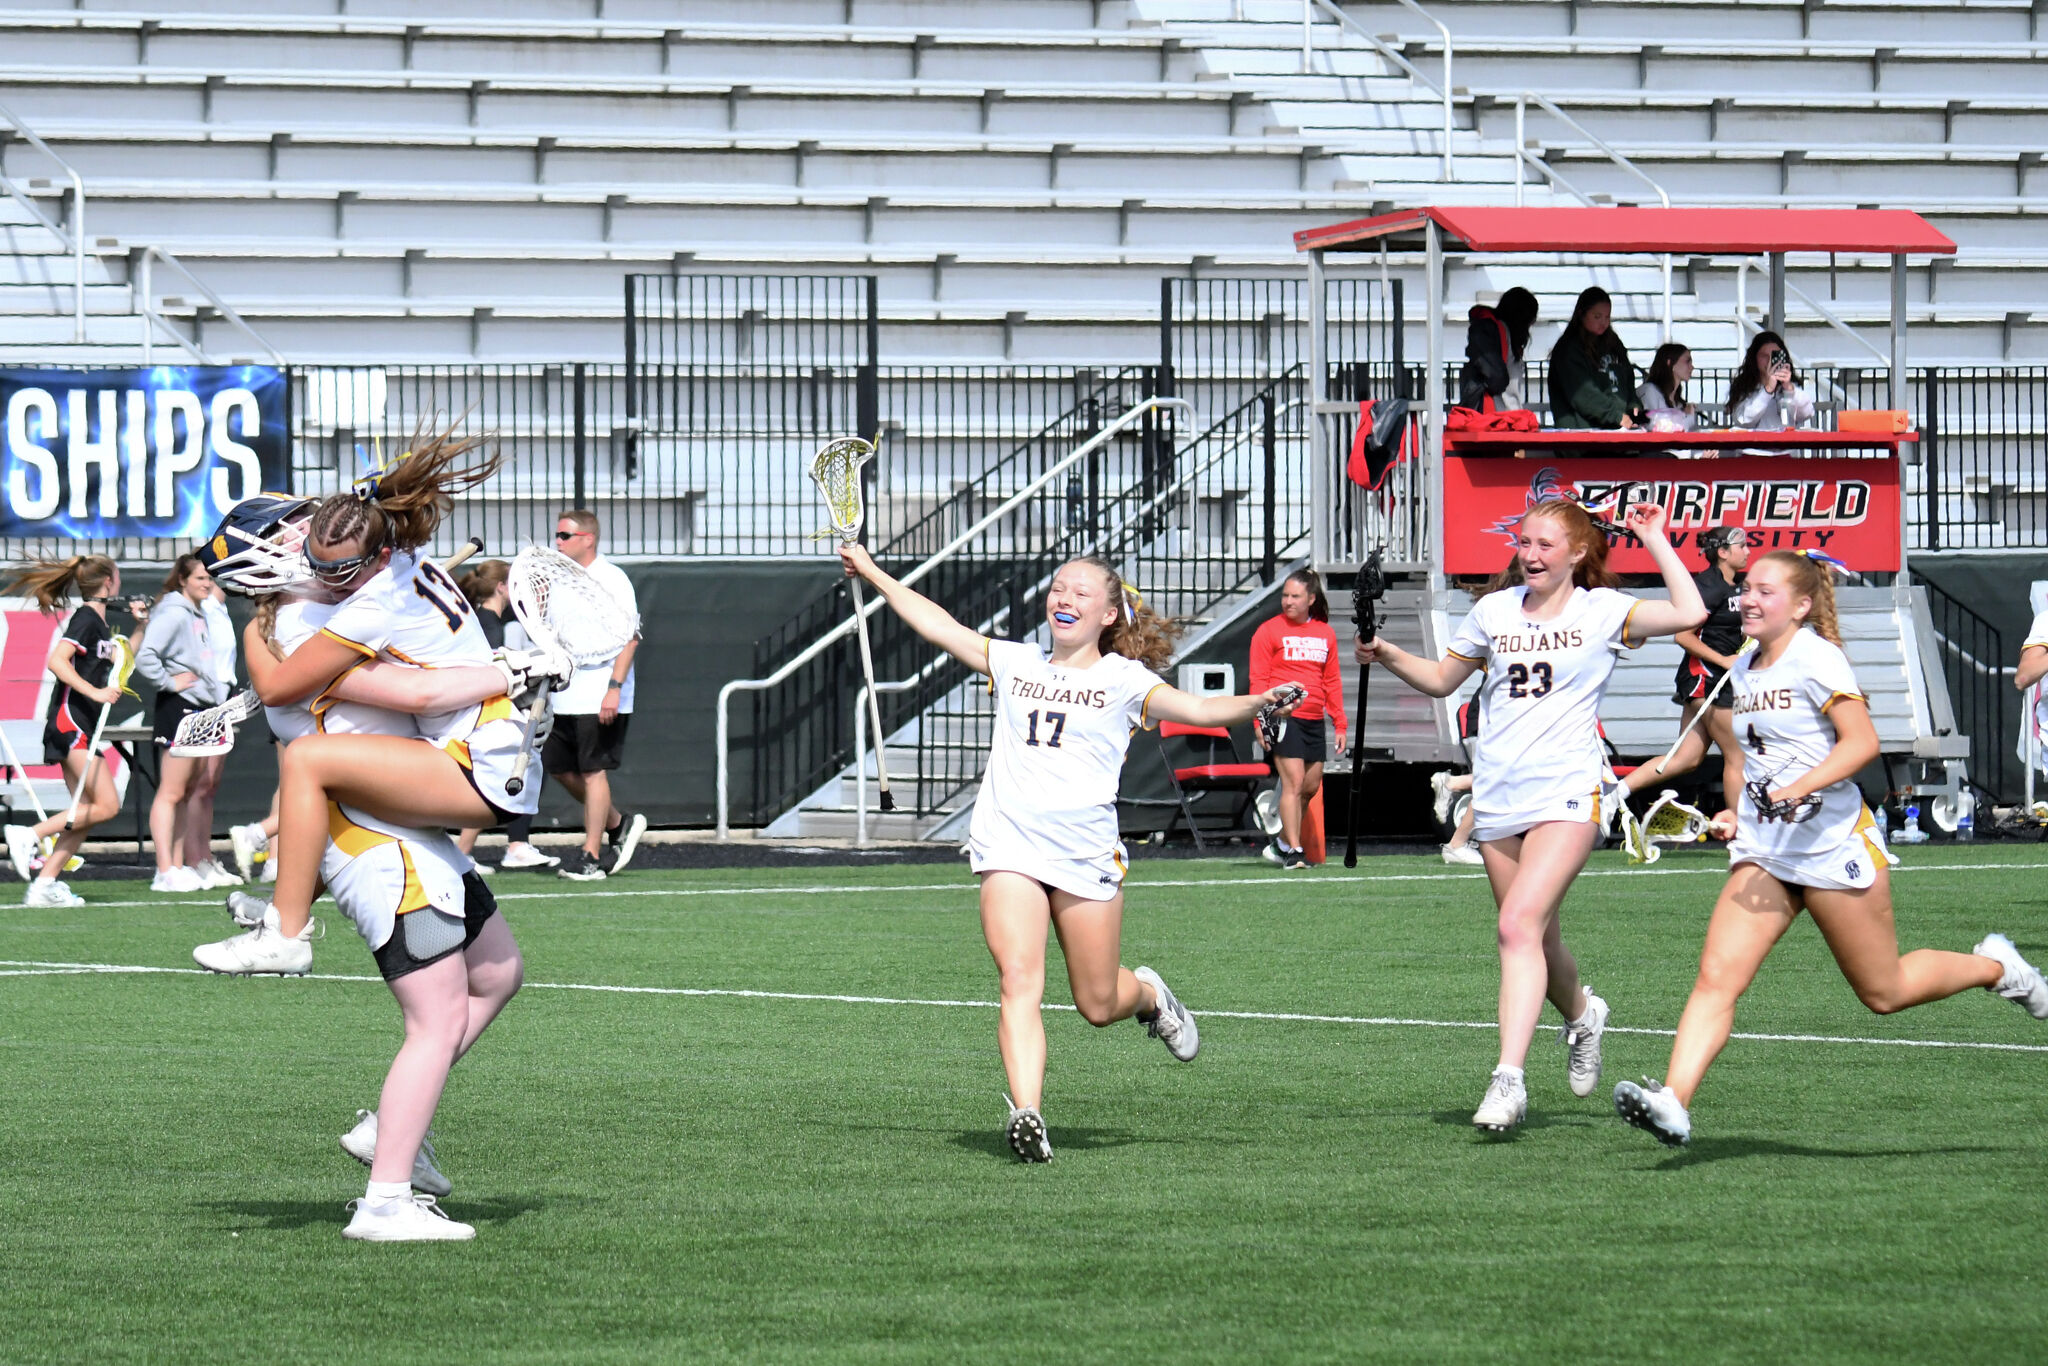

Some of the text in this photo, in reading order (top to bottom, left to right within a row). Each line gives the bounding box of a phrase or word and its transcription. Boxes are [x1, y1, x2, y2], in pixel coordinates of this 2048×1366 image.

[8, 387, 261, 519] SHIPS
[412, 561, 469, 635] 13
[1011, 676, 1106, 709] TROJANS
[1508, 661, 1553, 698] 23
[1026, 709, 1067, 748] 17
[1747, 723, 1766, 755] 4
